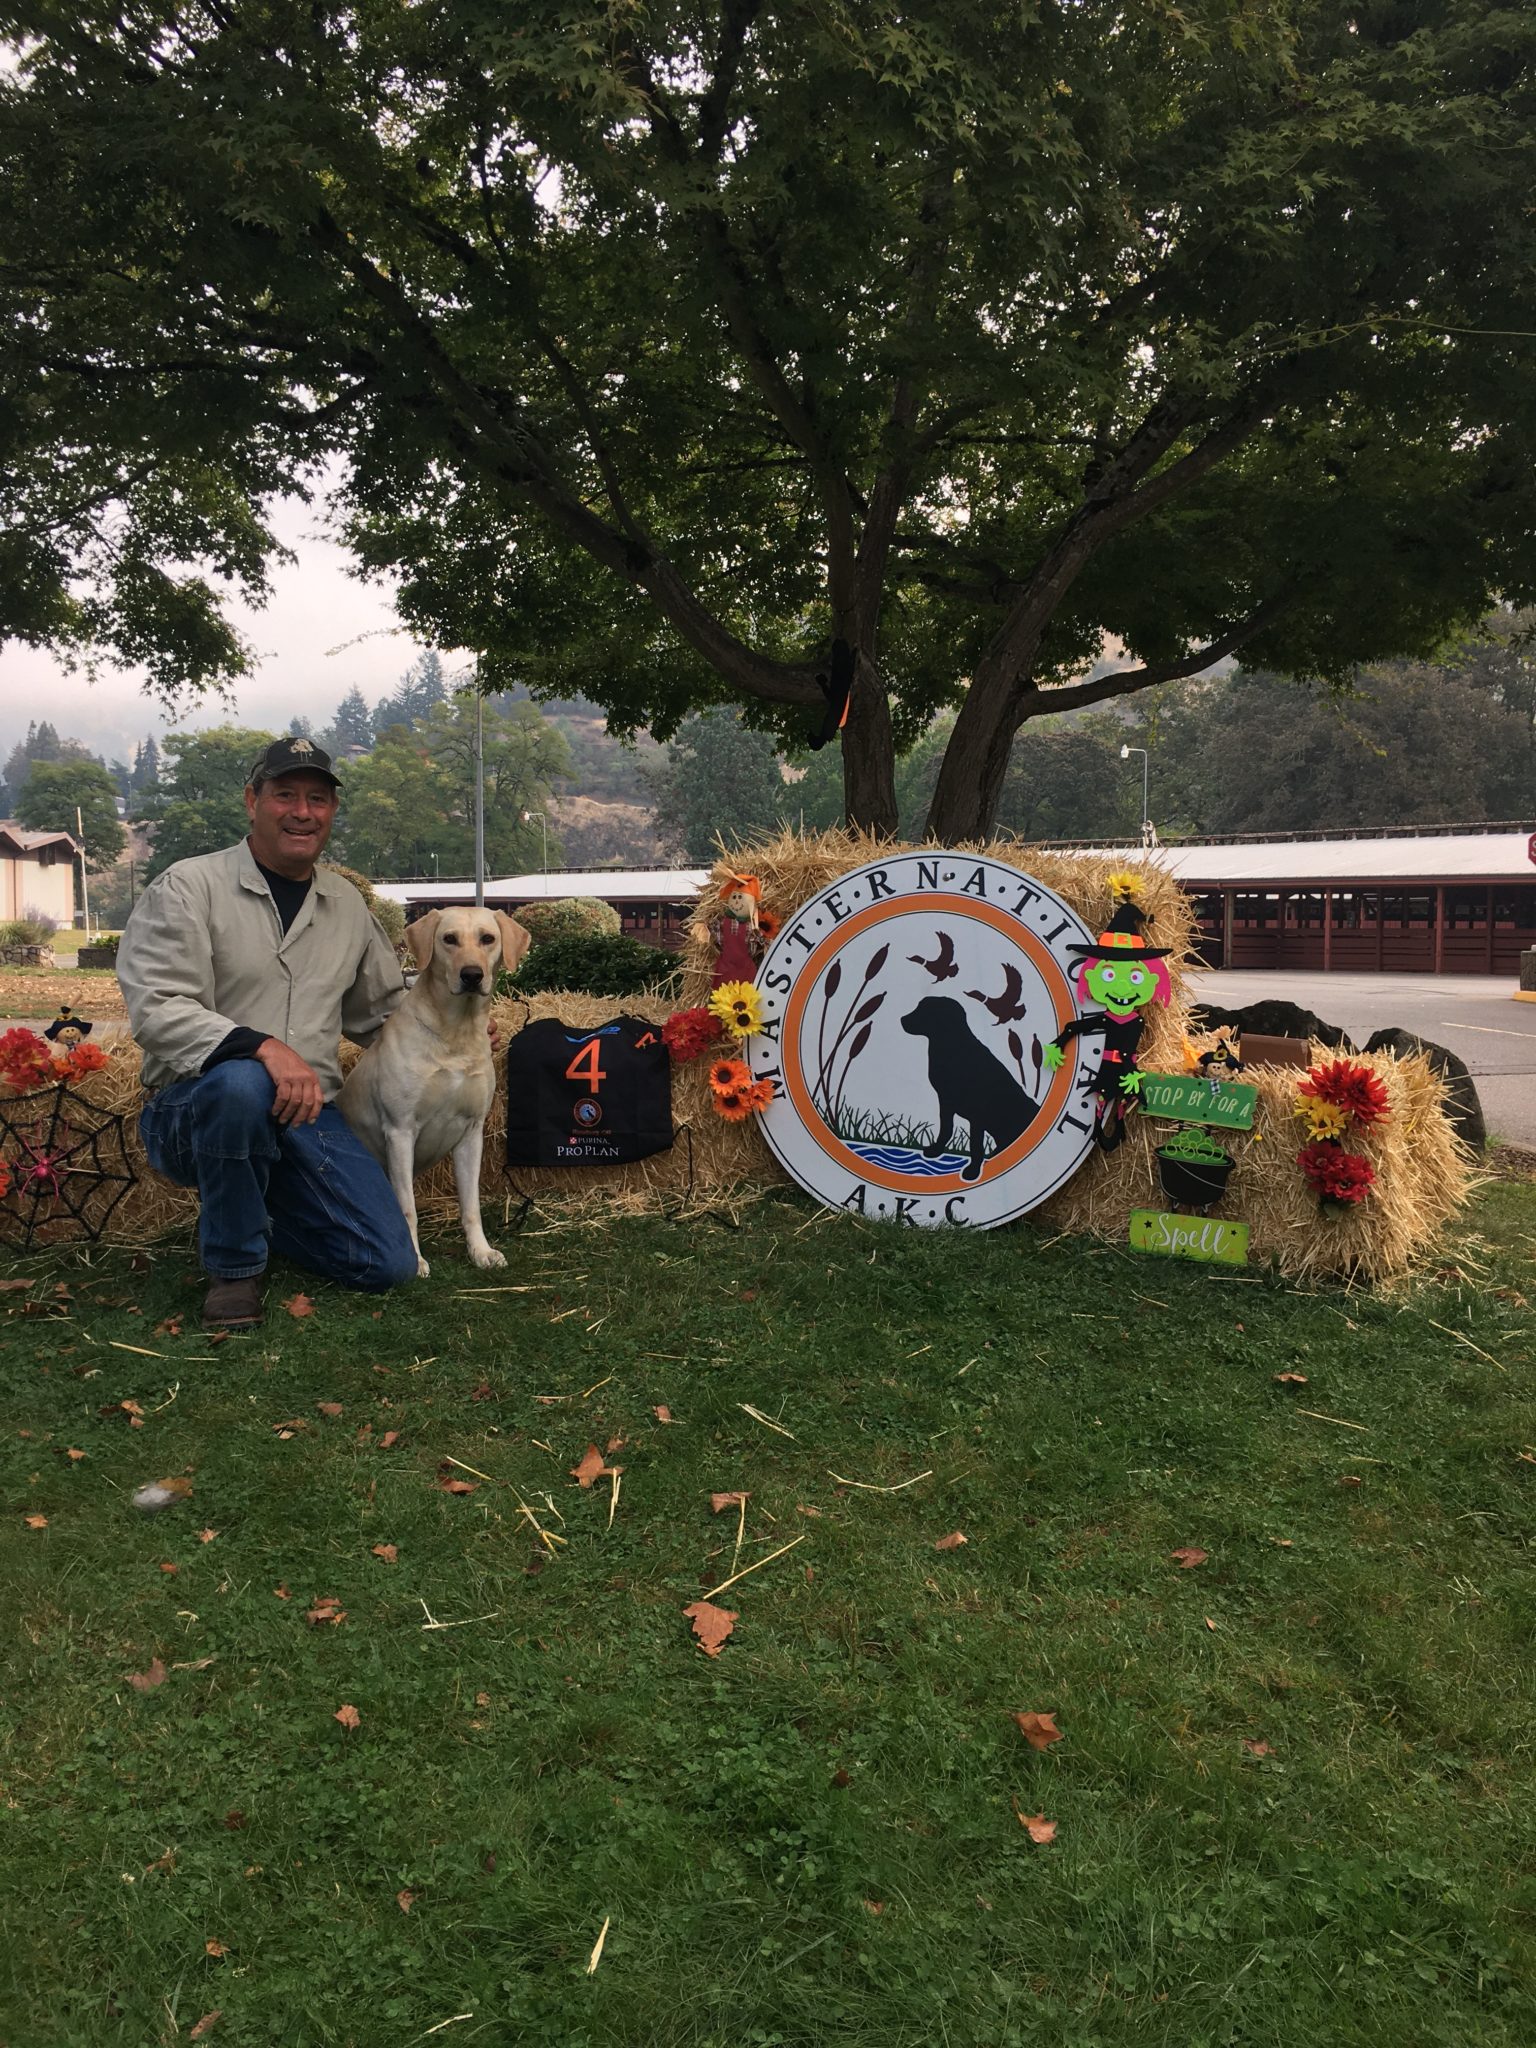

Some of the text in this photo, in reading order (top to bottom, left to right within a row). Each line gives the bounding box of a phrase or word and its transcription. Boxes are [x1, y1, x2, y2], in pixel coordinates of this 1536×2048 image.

[565, 1038, 607, 1094] 4
[1145, 1086, 1251, 1118] STOP BY FOR A
[557, 1145, 619, 1156] PRO PLAN
[1150, 1213, 1231, 1255] Spell
